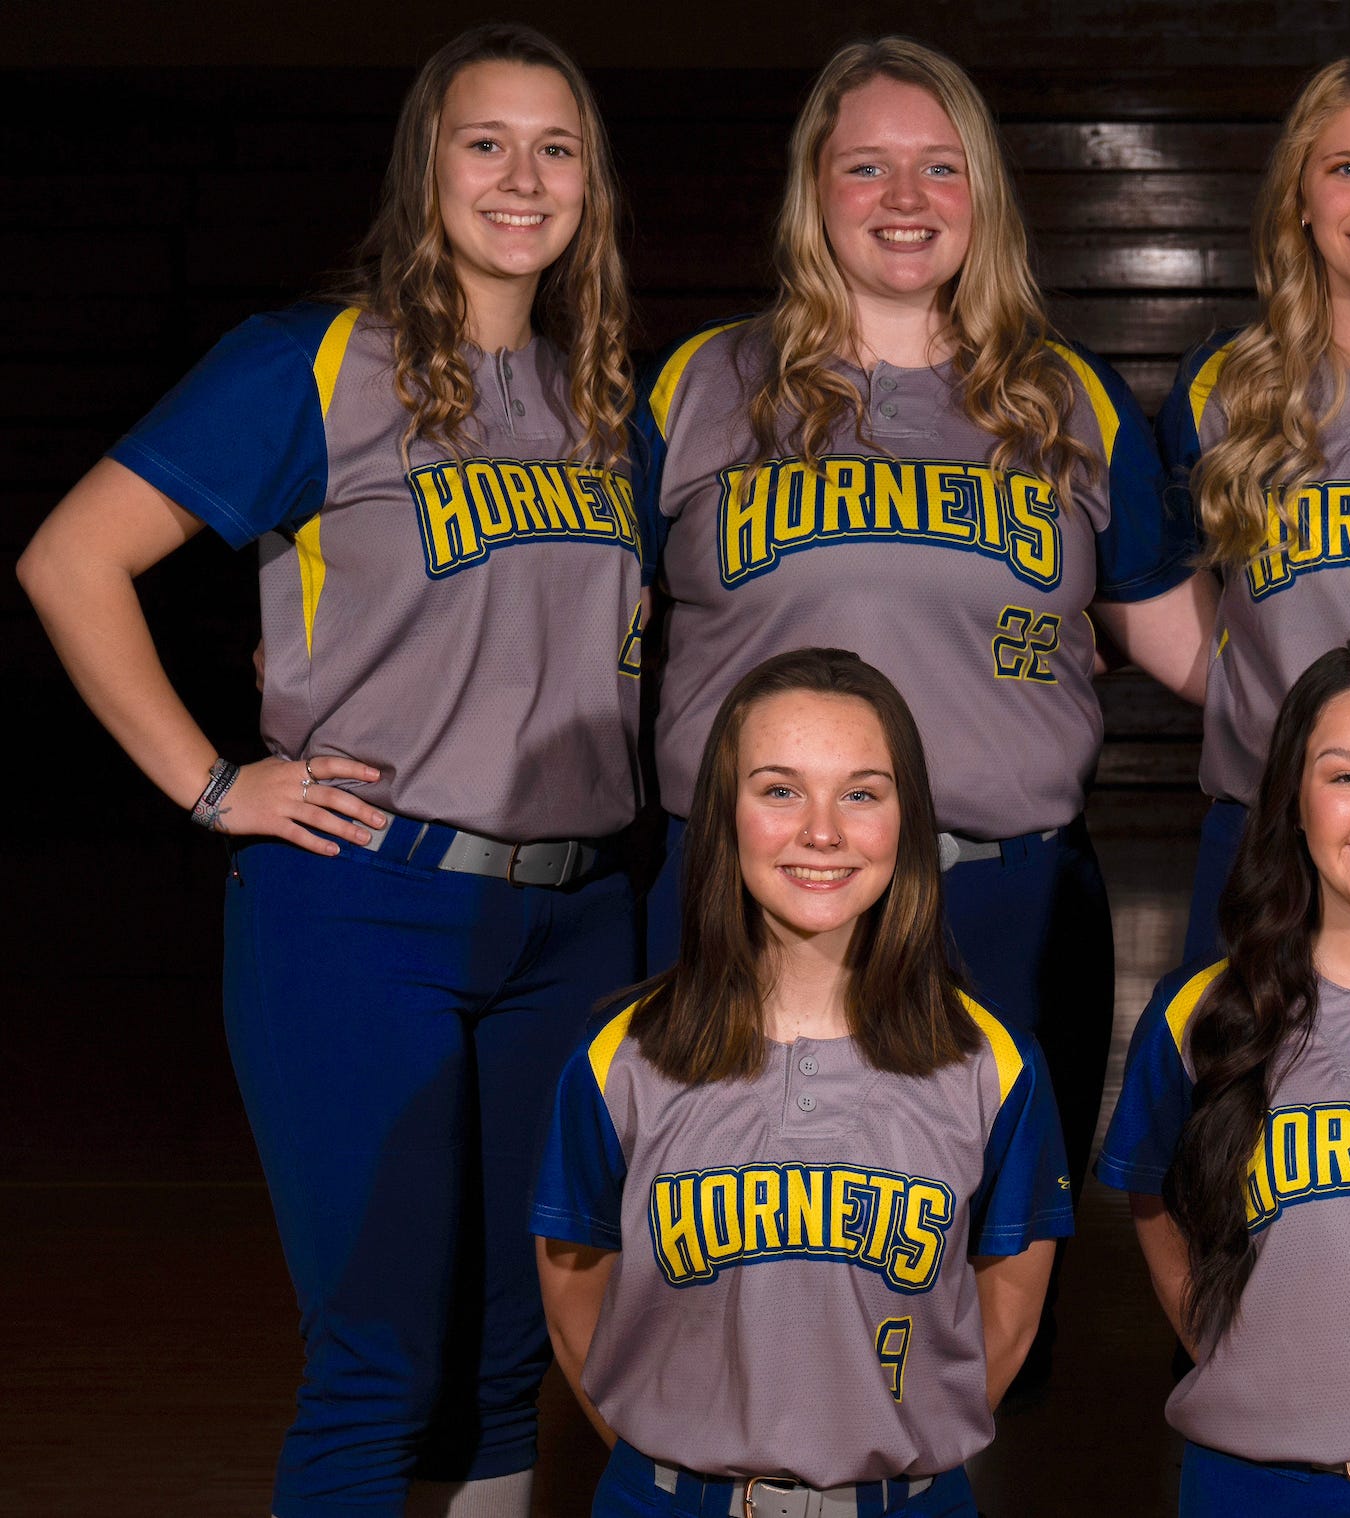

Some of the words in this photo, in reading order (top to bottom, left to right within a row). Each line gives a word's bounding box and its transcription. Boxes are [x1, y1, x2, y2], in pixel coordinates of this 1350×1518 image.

[716, 454, 1064, 593] HORNETS
[991, 604, 1063, 684] 22
[648, 1161, 957, 1296] HORNETS
[874, 1315, 912, 1404] 9
